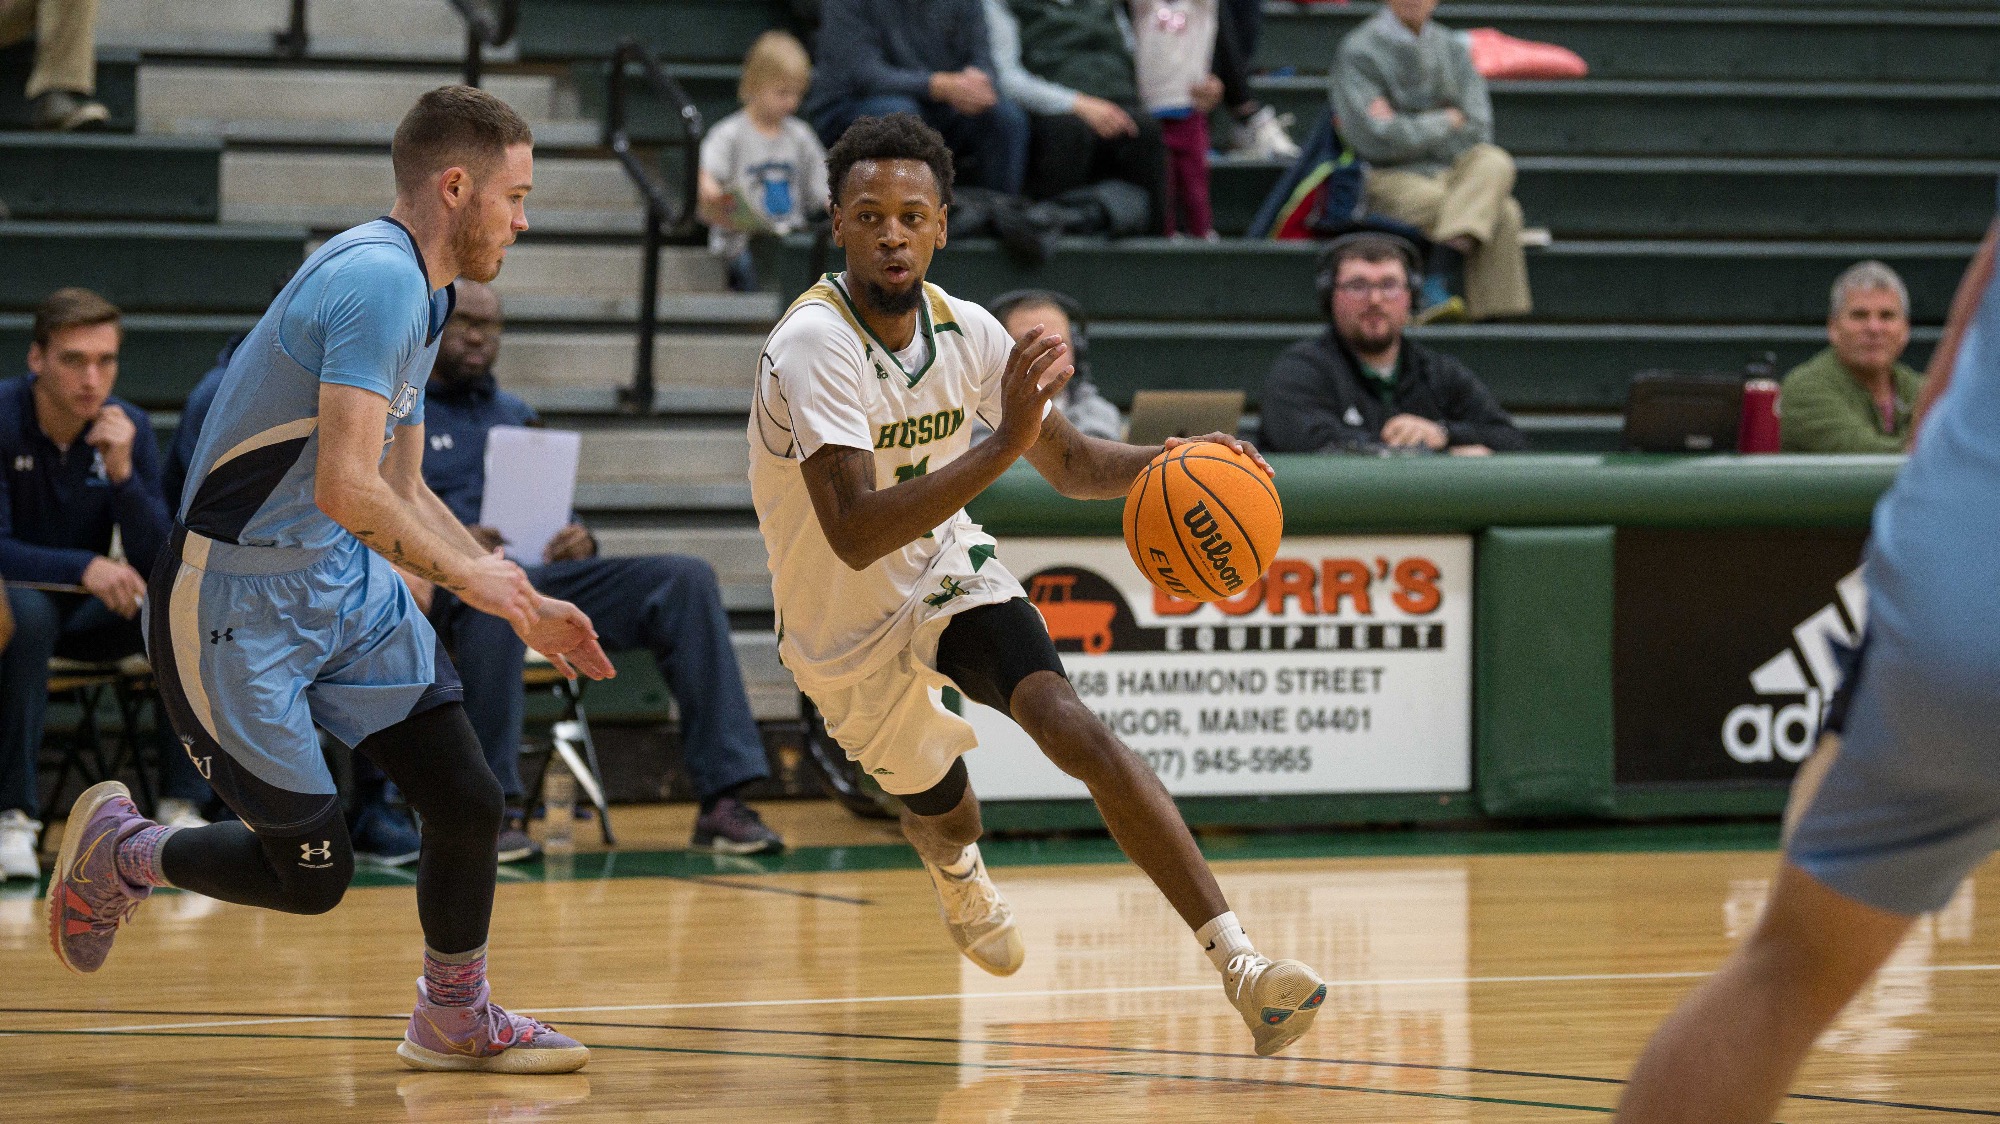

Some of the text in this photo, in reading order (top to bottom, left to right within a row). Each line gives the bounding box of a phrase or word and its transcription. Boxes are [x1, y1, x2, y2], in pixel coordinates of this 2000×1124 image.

[1183, 499, 1244, 592] Wilson
[1164, 625, 1433, 650] EQUIPMENT
[1116, 669, 1268, 696] HAMMOND
[1275, 666, 1384, 695] STREET
[1100, 706, 1372, 739] NGOR, MAINE 04401
[1193, 745, 1313, 775] 945-5965
